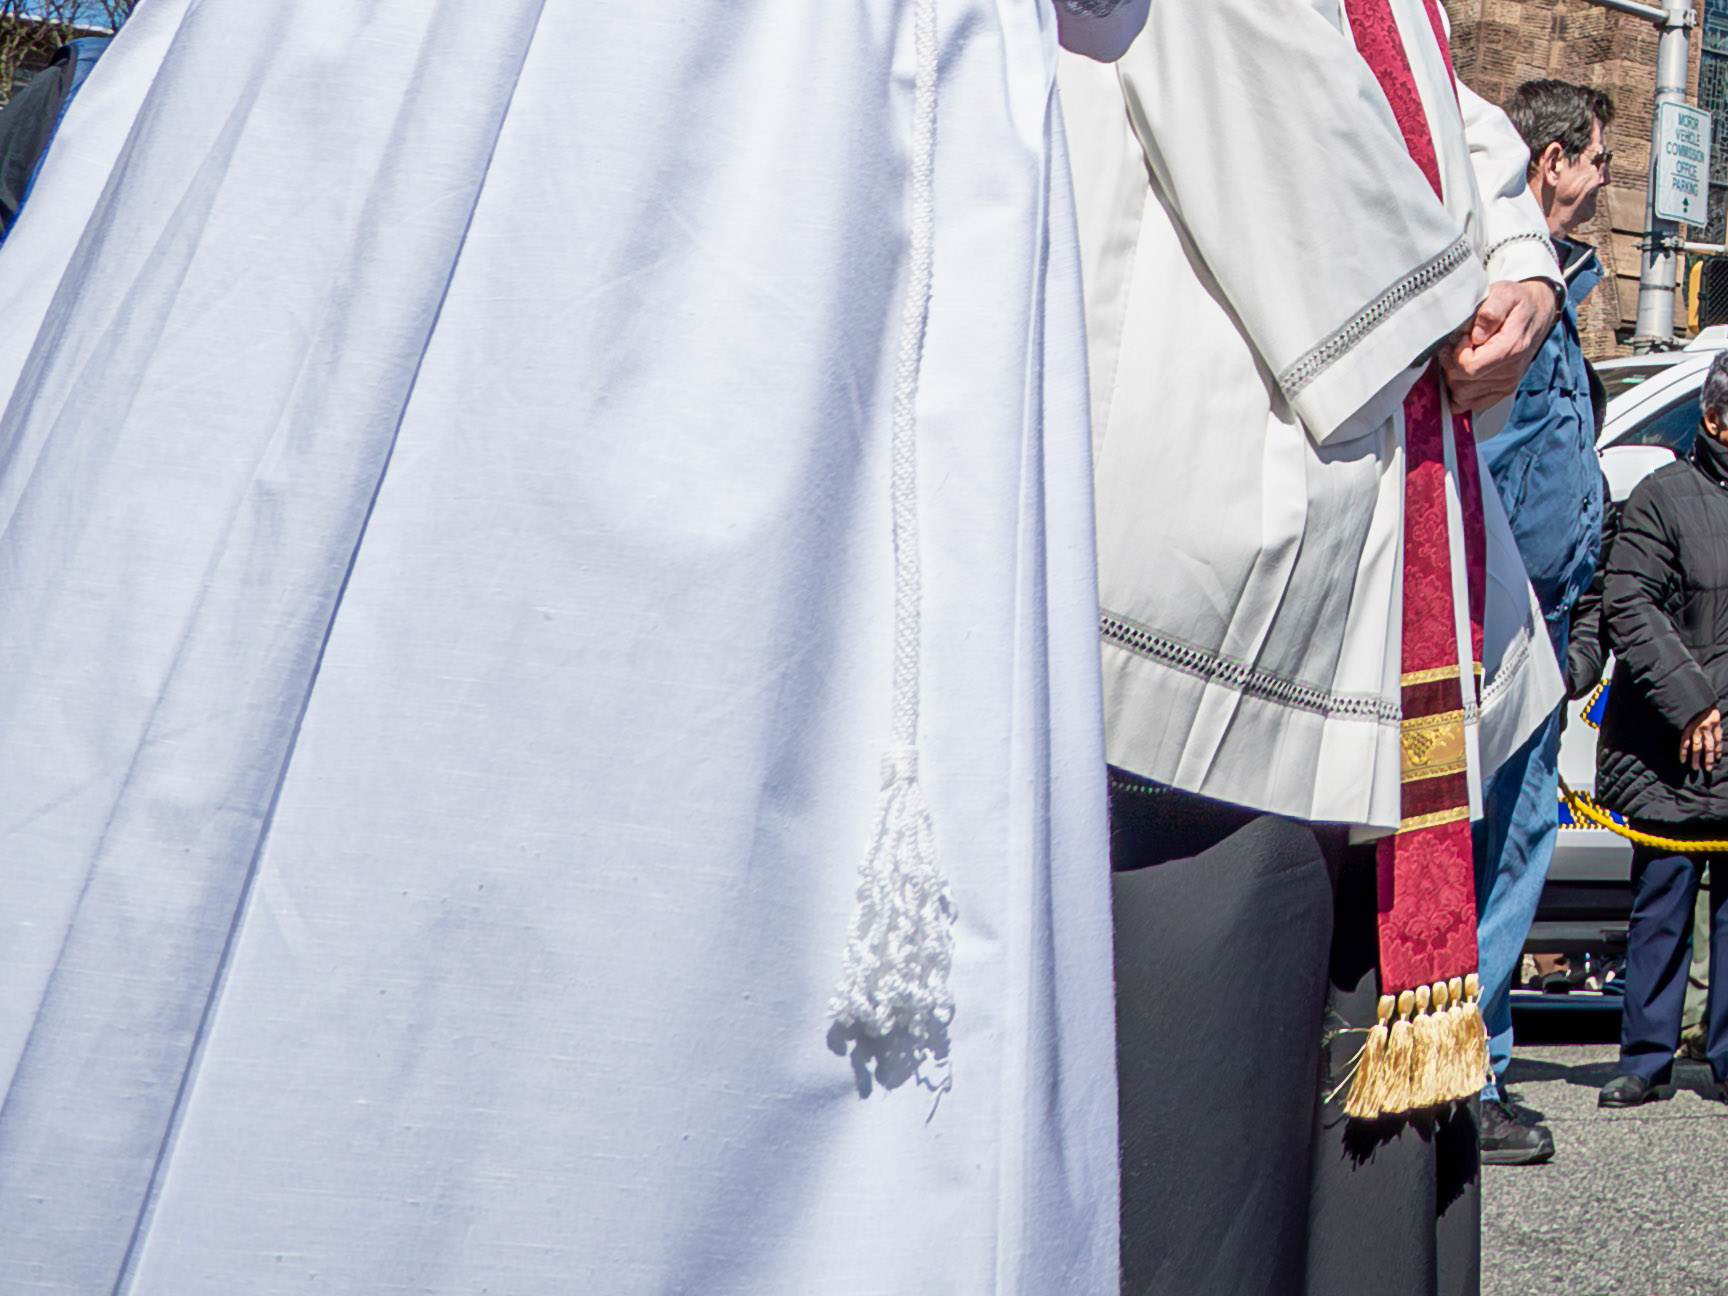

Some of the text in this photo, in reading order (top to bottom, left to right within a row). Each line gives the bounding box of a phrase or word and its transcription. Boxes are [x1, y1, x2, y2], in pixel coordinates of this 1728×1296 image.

[1675, 128, 1701, 147] VEHICLE
[1665, 141, 1705, 163] COMMISSION
[1676, 160, 1698, 178] OFFICE
[1672, 177, 1699, 197] PARKING
